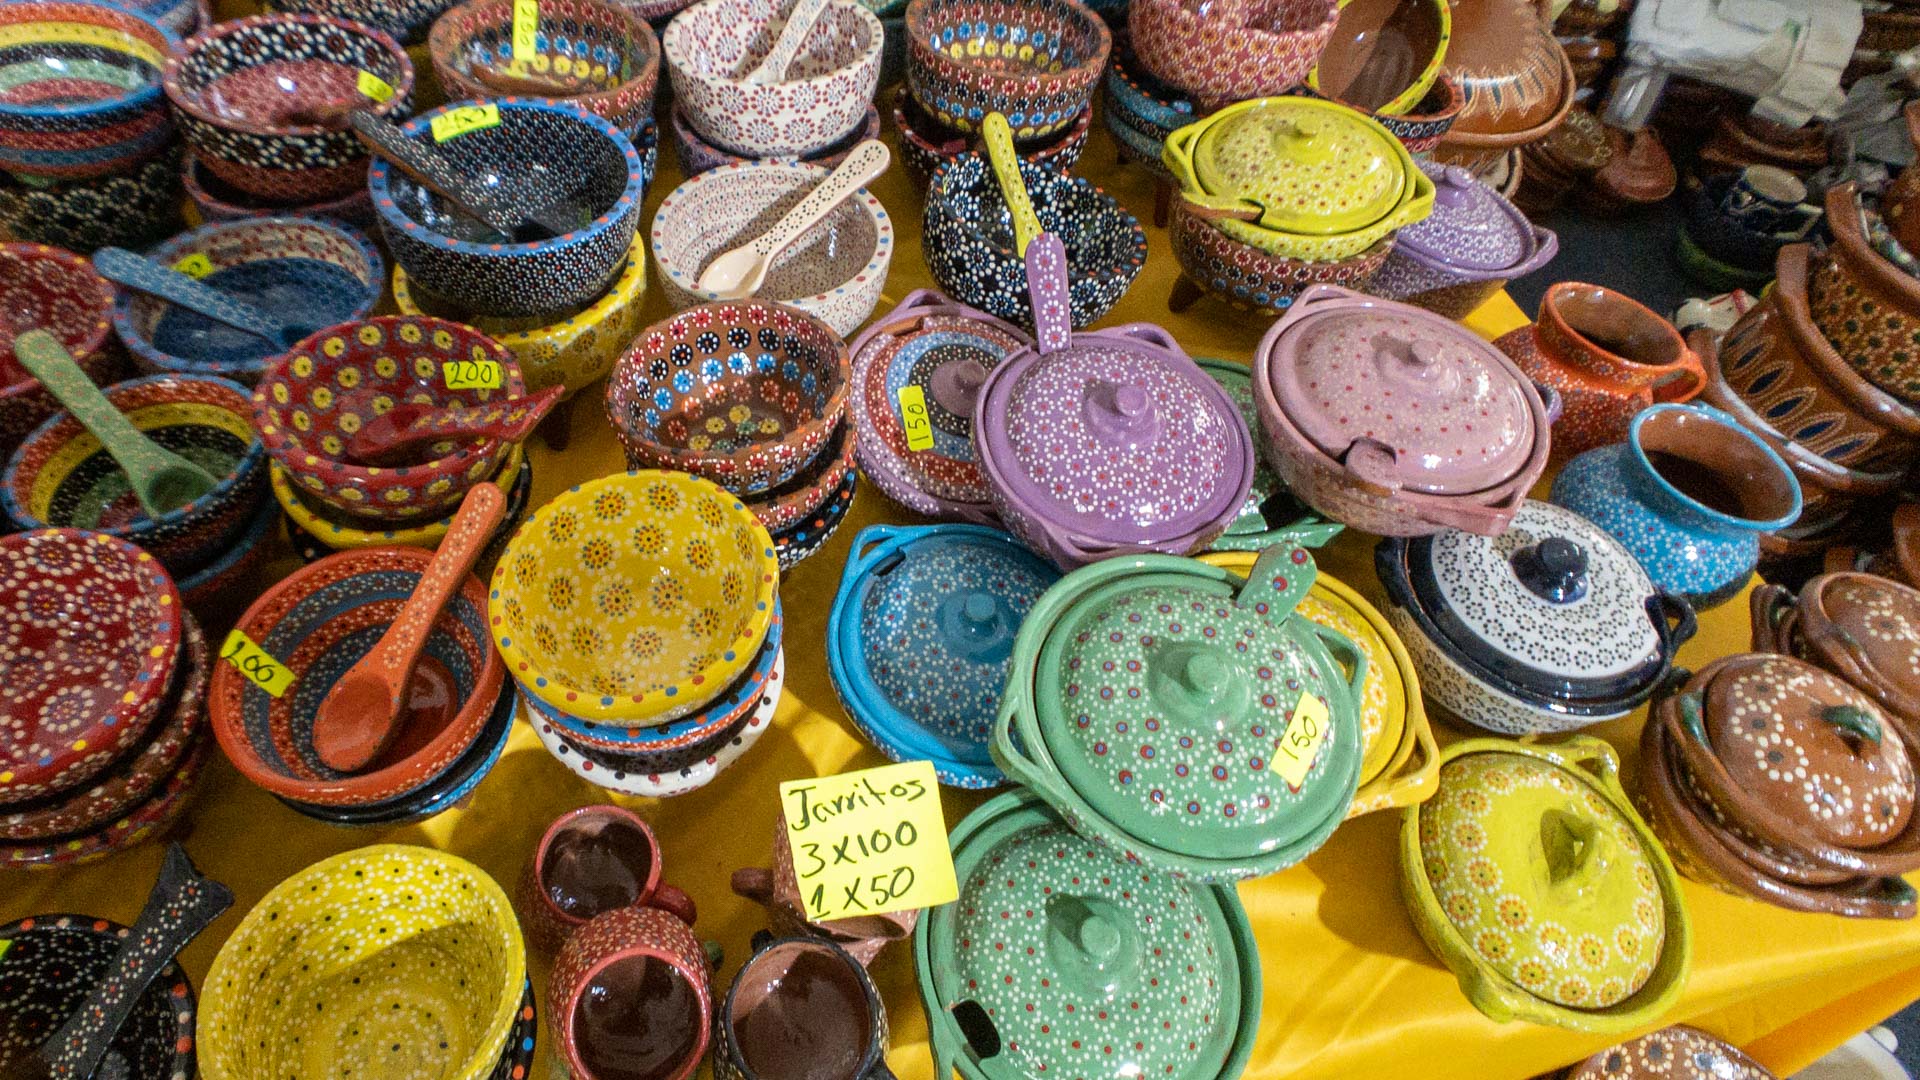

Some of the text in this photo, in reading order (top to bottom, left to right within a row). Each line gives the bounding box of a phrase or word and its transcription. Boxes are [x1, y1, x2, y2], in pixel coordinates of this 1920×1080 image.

[450, 360, 492, 385] 200
[907, 403, 929, 442] 150
[1281, 715, 1317, 760] 150
[788, 778, 926, 831] Jarritos
